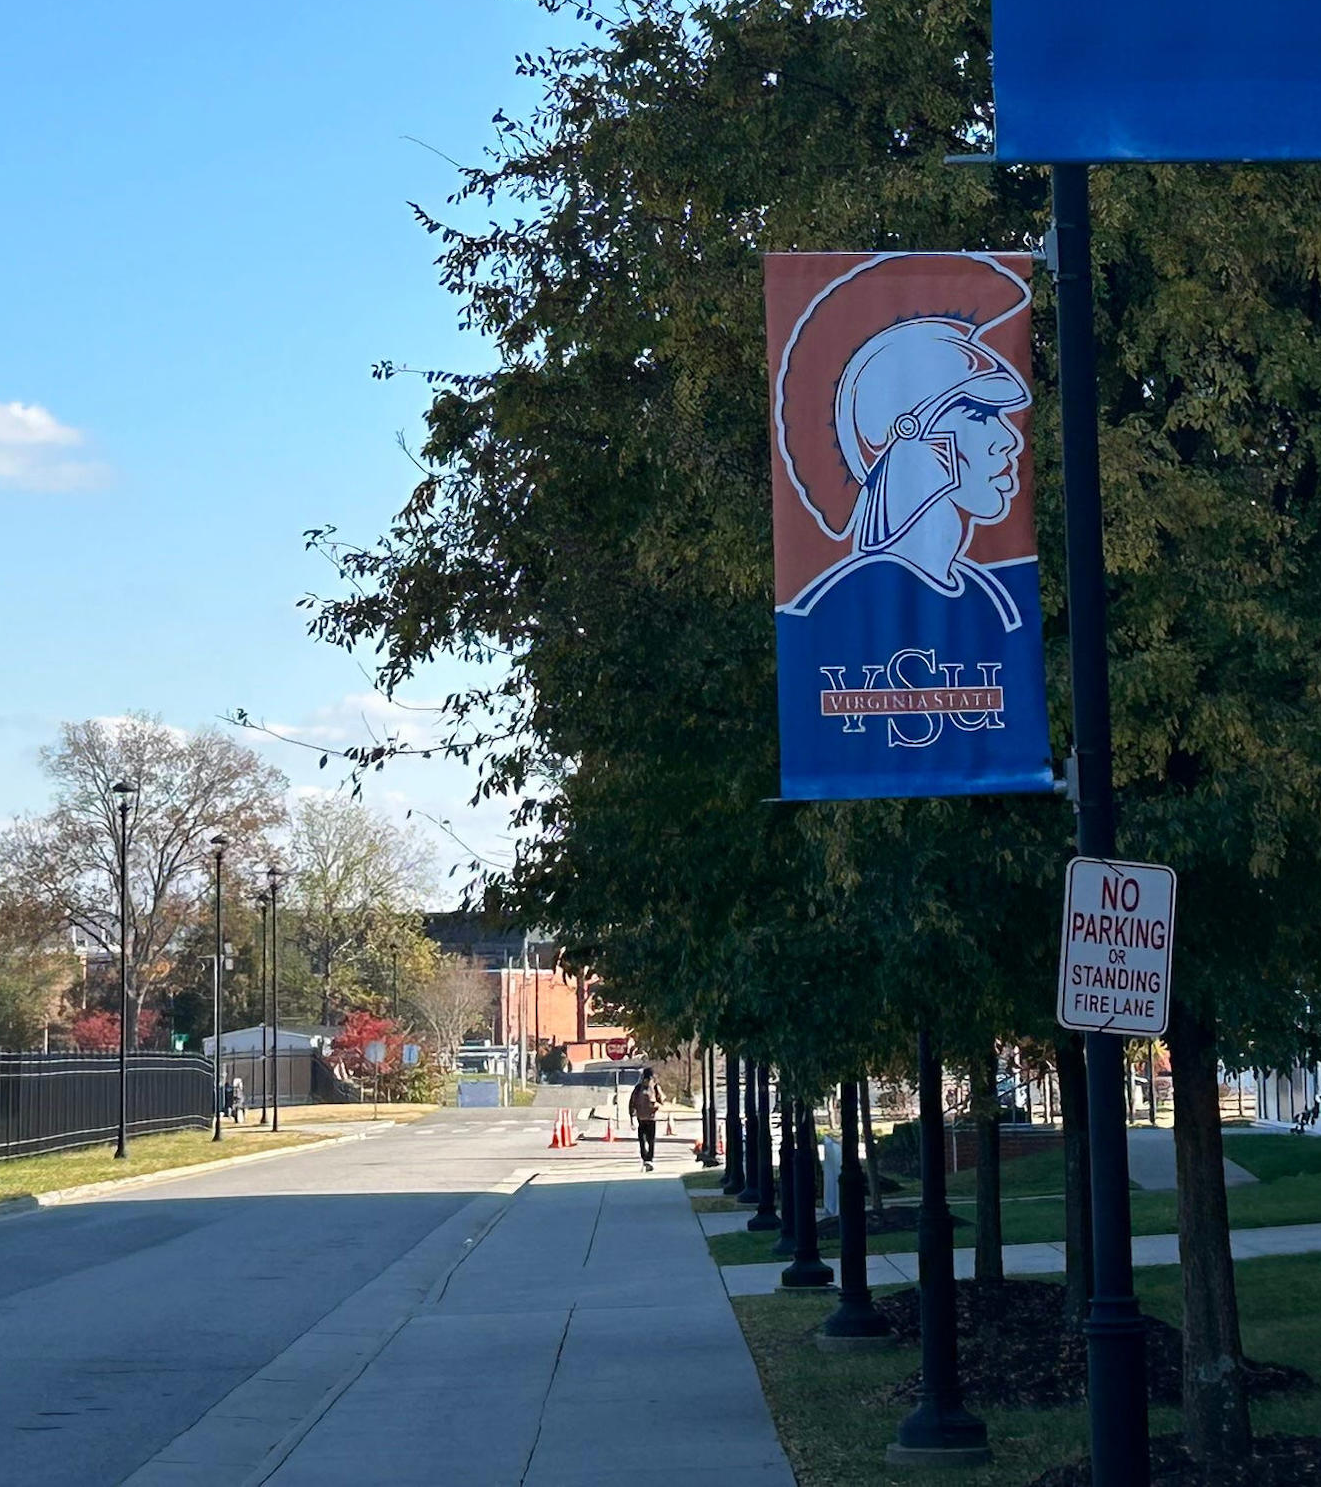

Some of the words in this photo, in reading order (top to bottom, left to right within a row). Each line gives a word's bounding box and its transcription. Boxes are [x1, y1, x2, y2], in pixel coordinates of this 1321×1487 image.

[829, 693, 929, 711] VIRGINIA
[1101, 875, 1140, 913] NO
[1071, 912, 1166, 950] PARKING
[1108, 948, 1127, 965] OR
[1071, 964, 1161, 994] STANDING
[1074, 993, 1110, 1014] FIRE
[1113, 996, 1155, 1018] LANE
